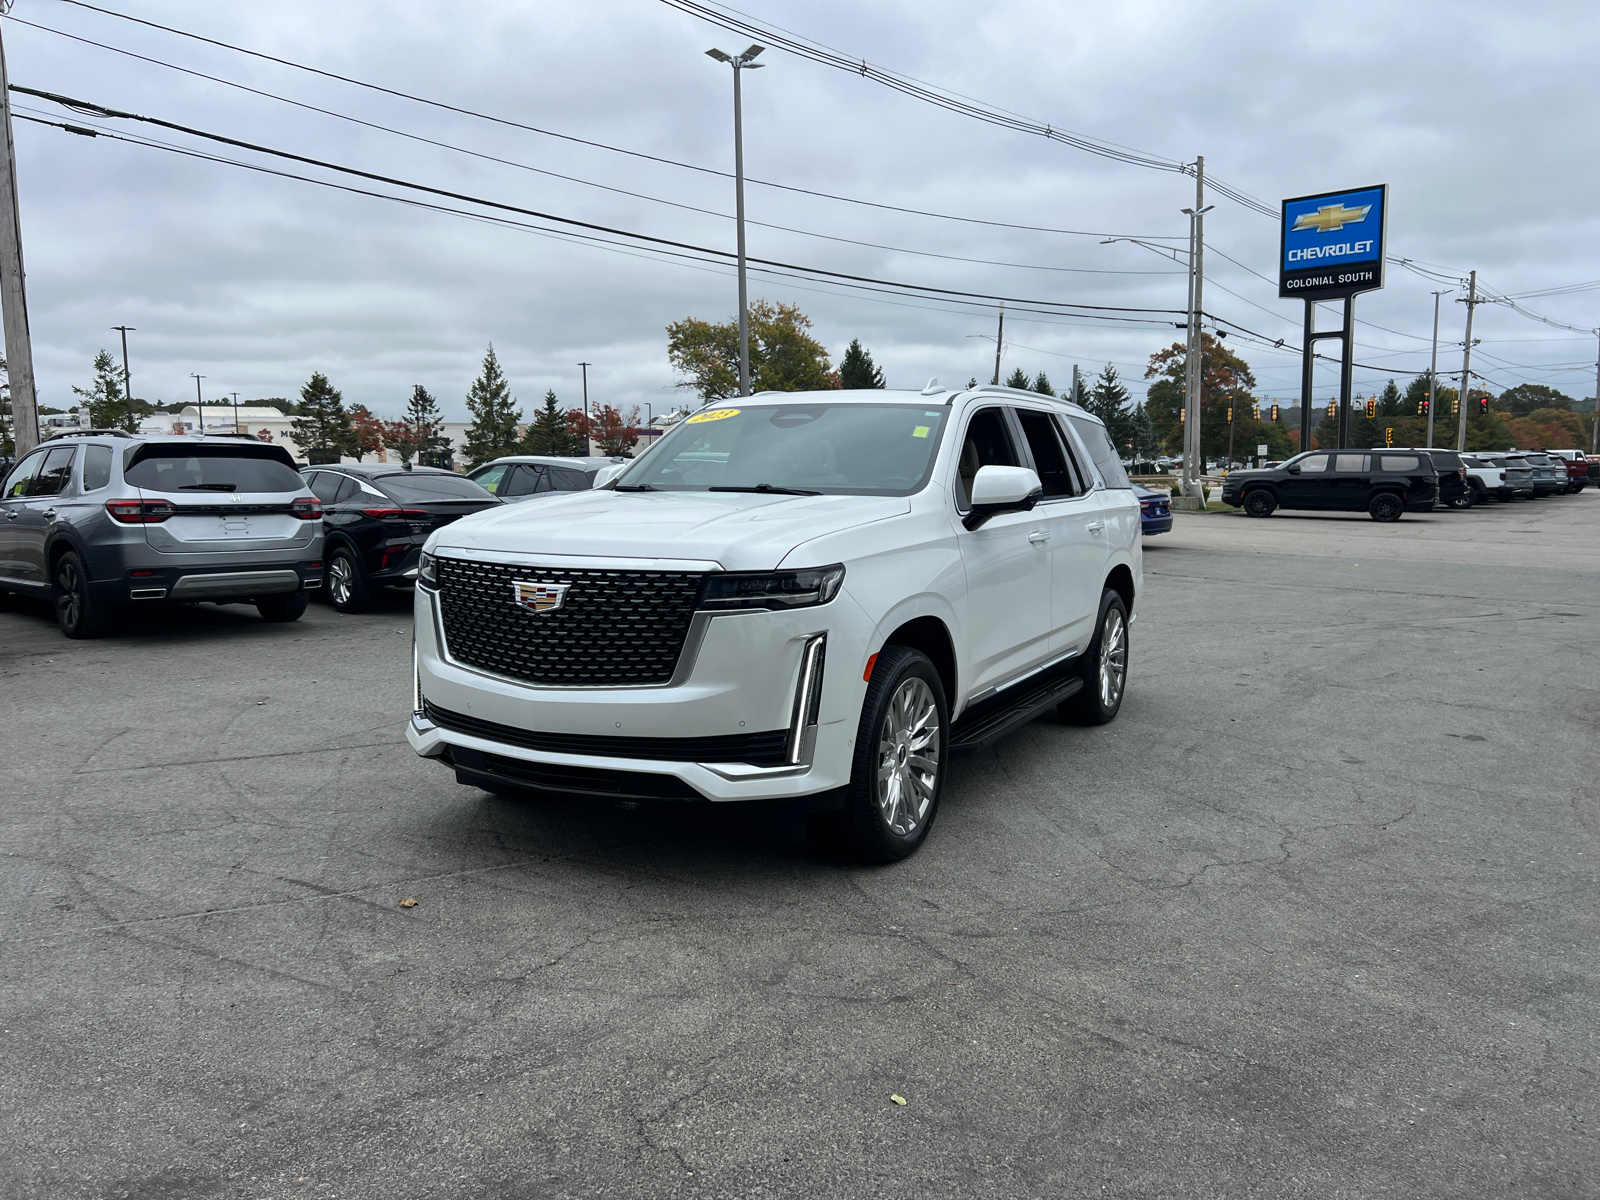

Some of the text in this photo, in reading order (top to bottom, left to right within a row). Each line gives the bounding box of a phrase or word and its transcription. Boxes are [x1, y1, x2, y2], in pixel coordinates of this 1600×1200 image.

[1288, 240, 1373, 261] CHEVROLET
[1286, 271, 1373, 289] COLONIAL SOUTH
